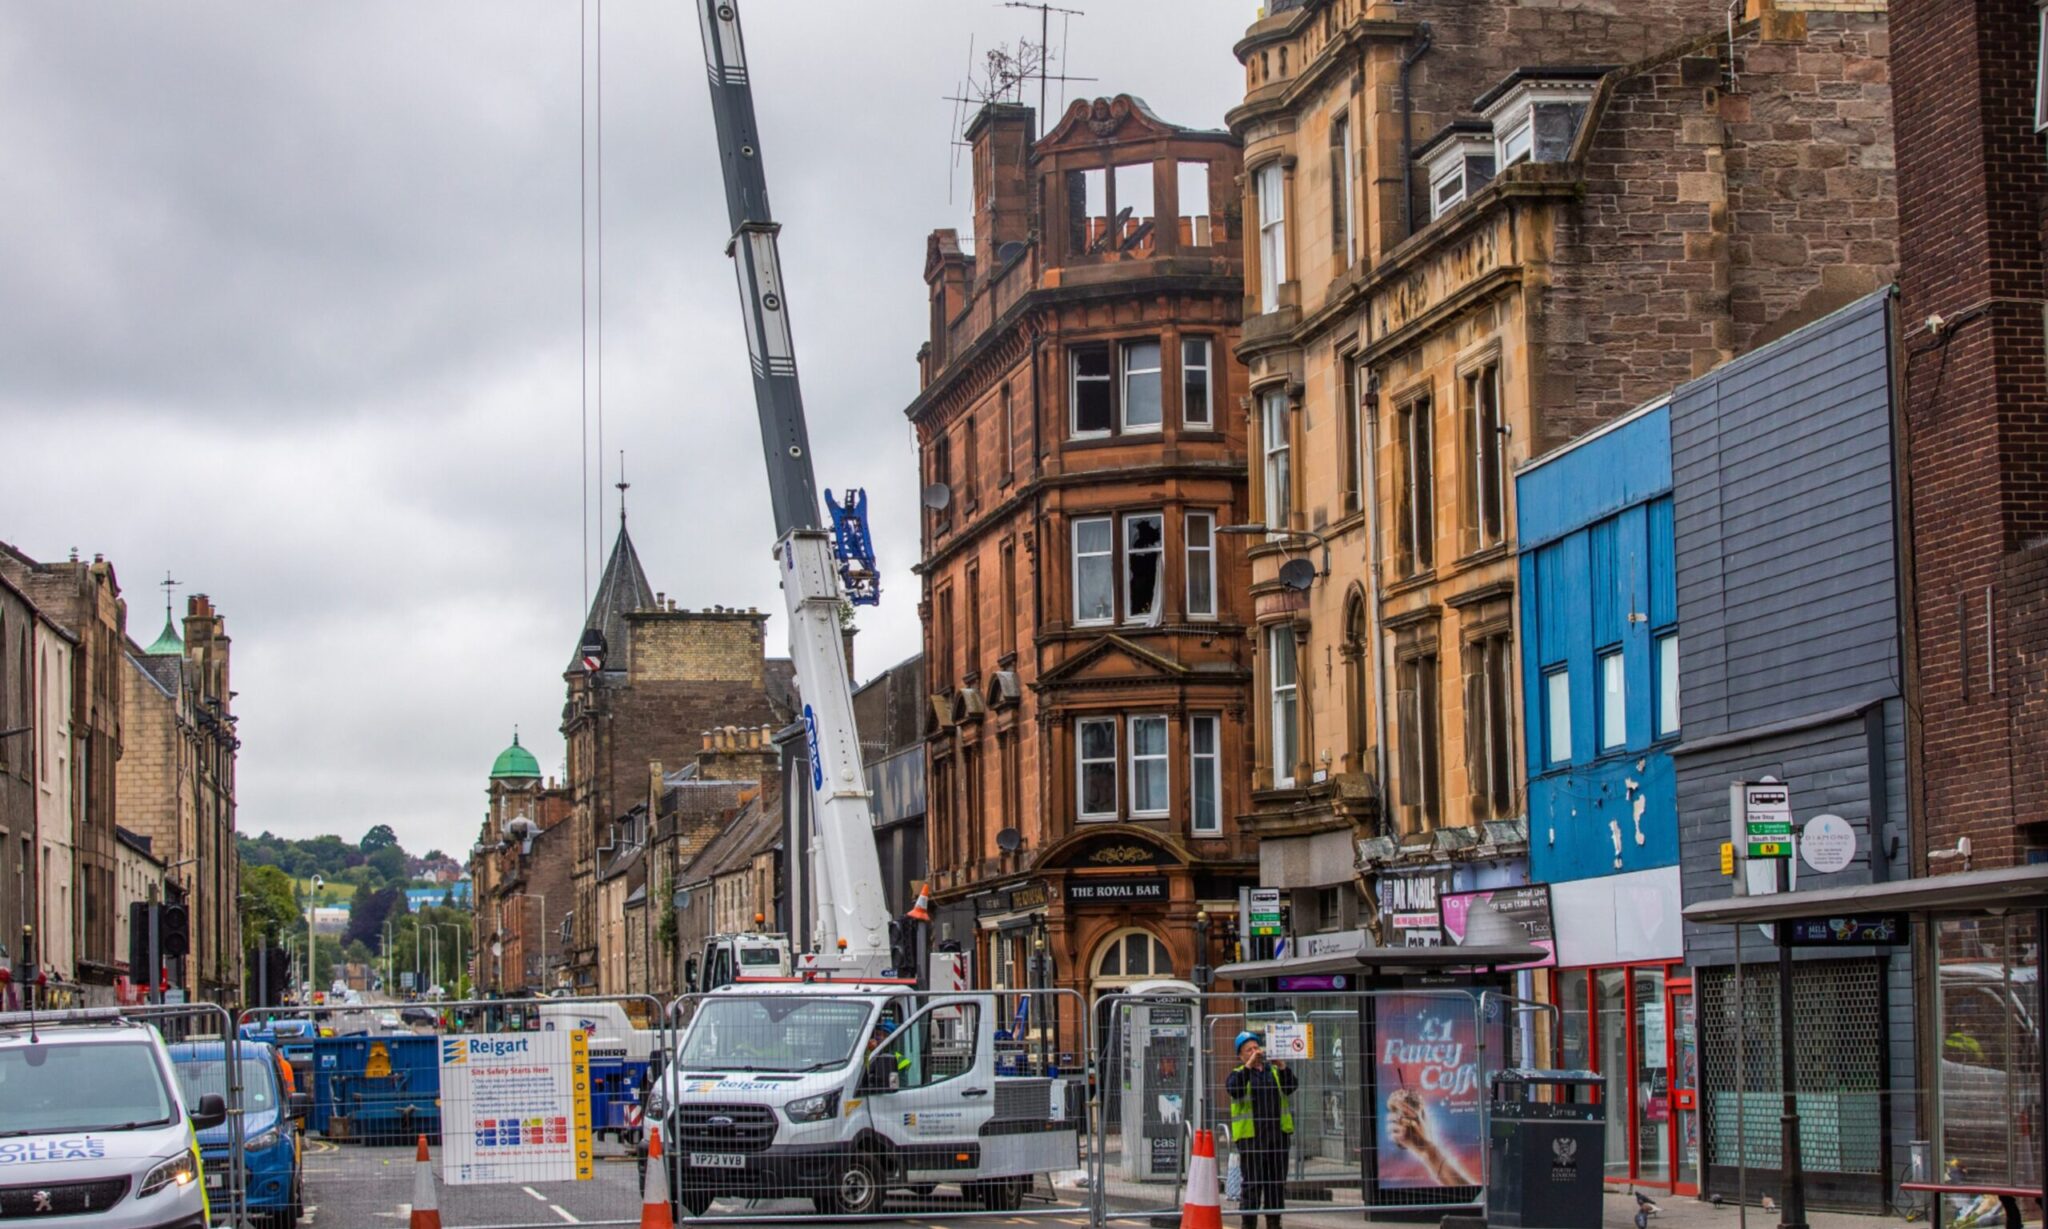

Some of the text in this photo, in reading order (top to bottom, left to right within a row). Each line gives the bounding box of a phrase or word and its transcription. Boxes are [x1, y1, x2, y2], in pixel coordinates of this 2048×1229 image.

[1765, 844, 1774, 853] M
[1072, 885, 1160, 897] THE ROYAL BAR
[1394, 879, 1406, 909] MR
[1407, 876, 1436, 909] MOBILE
[1445, 897, 1460, 909] To
[1408, 936, 1425, 948] MR
[1419, 1017, 1453, 1042] £1
[469, 1037, 529, 1056] Reigart
[1382, 1037, 1463, 1069] Fancy
[471, 1066, 549, 1076] Site Safety Starts Here
[716, 1080, 780, 1090] Reigart
[573, 1034, 589, 1175] DEMOLITION
[1153, 1138, 1177, 1148] cas
[694, 1154, 720, 1166] YP73
